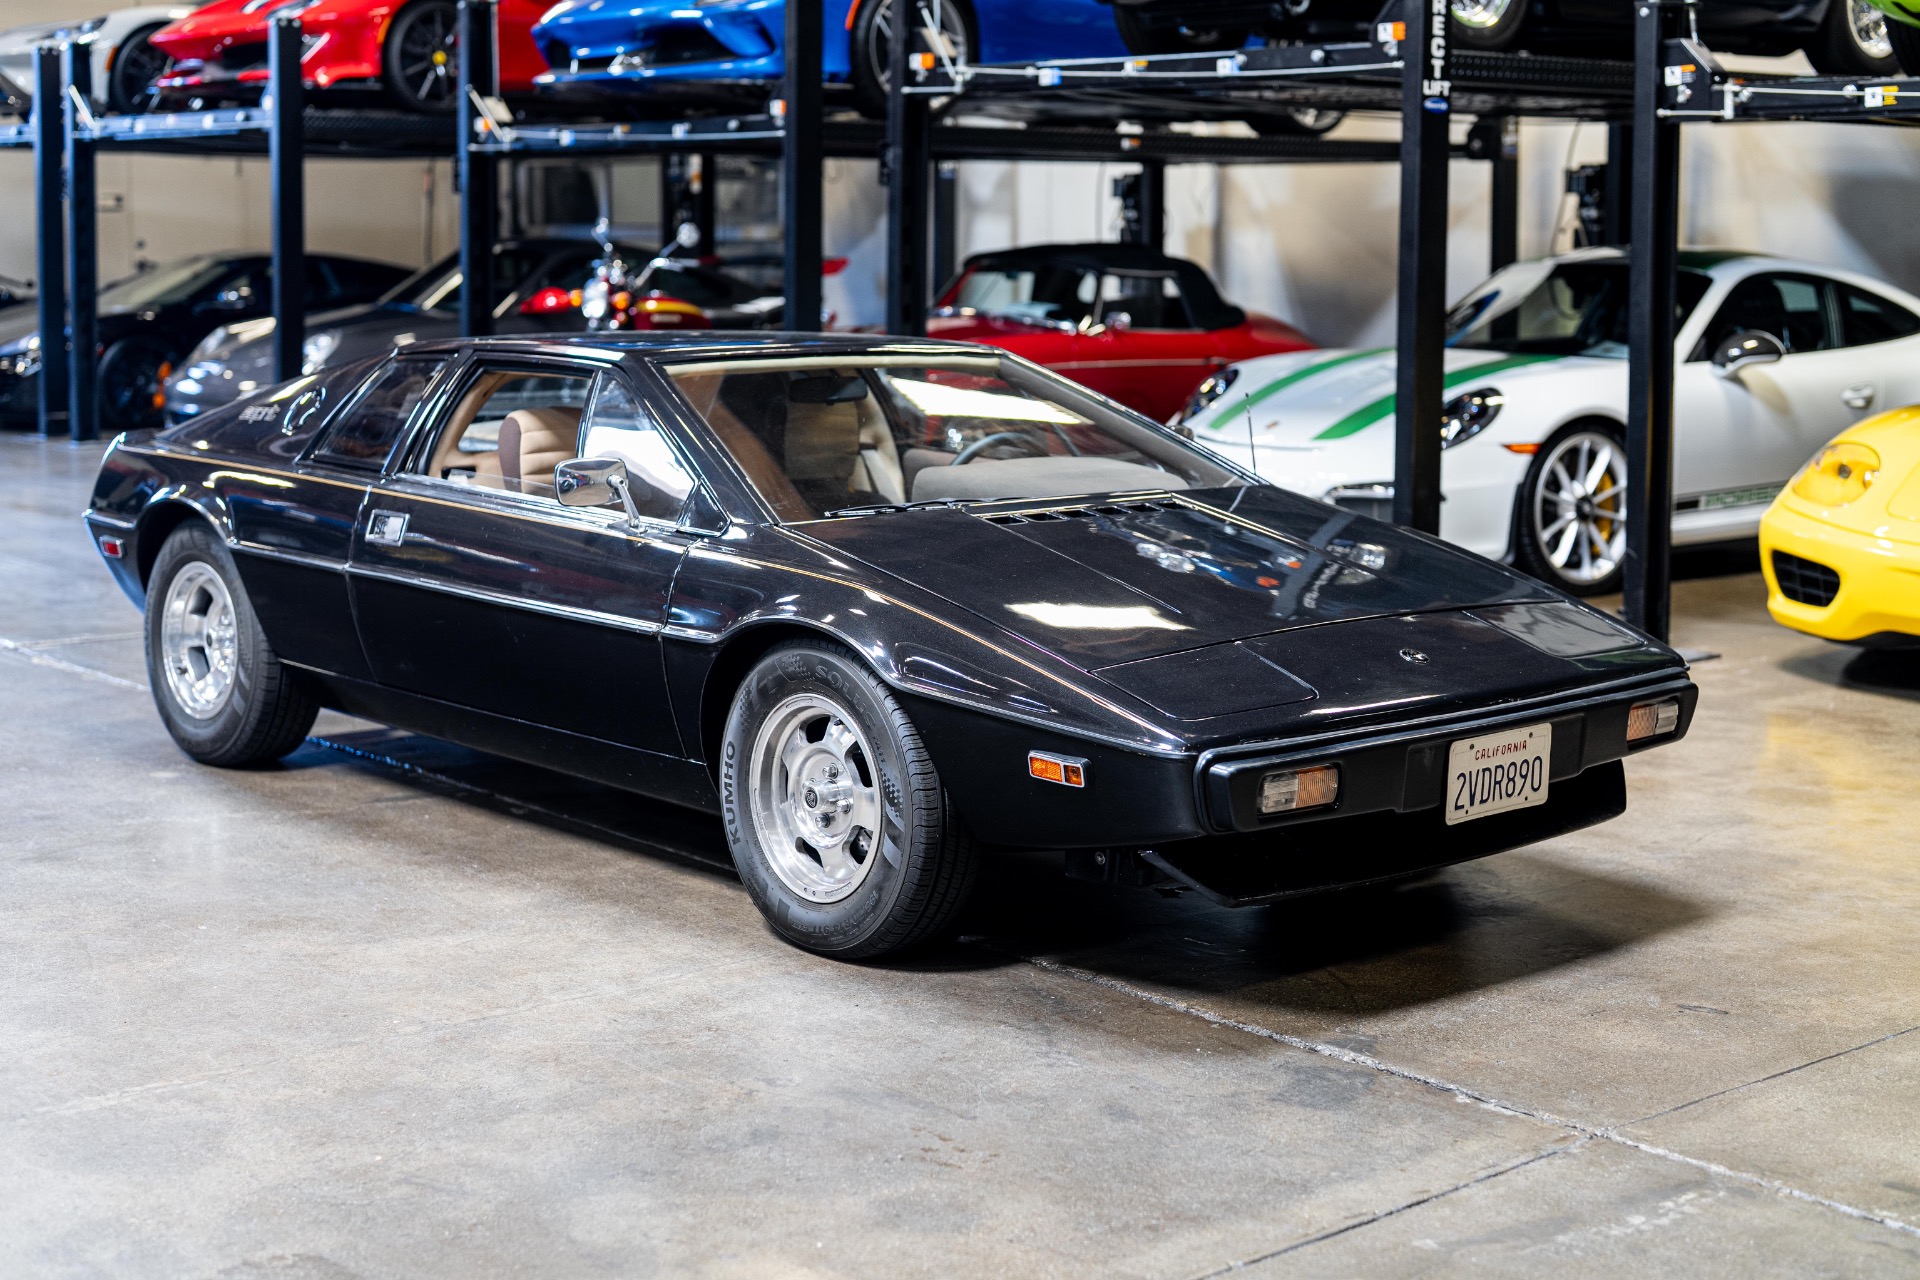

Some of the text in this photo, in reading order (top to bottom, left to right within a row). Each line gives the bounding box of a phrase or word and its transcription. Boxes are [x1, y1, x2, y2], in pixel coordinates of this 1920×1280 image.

[1423, 79, 1451, 97] LIFT
[815, 665, 879, 730] SOLUS
[1475, 740, 1527, 761] CALIFORNIA
[722, 740, 742, 846] KUMHO
[1454, 755, 1543, 811] 2VDR890
